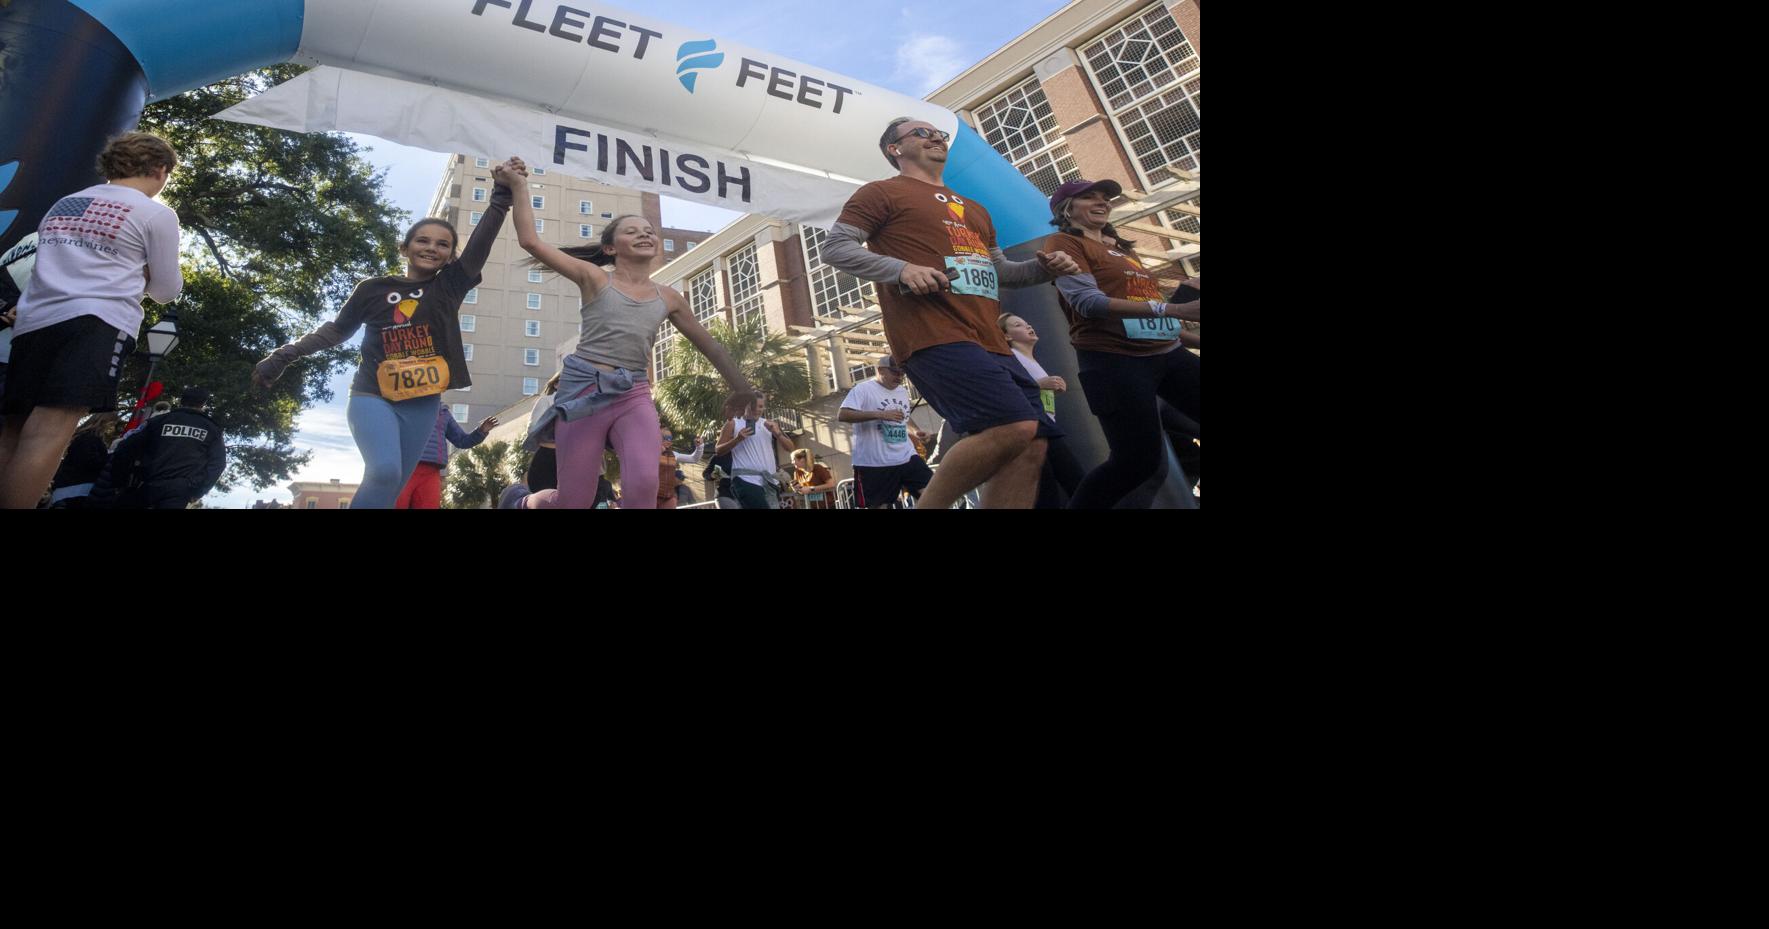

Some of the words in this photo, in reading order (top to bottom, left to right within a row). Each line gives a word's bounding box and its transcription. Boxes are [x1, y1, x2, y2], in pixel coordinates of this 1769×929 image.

[471, 0, 663, 60] FLEET
[735, 57, 853, 114] FEET
[553, 125, 751, 203] FINISH
[39, 236, 84, 248] neyard
[960, 268, 995, 290] 1869
[382, 324, 430, 343] TURKEY
[388, 366, 440, 391] 7820
[163, 425, 207, 440] POLICE
[887, 430, 906, 439] 4446
